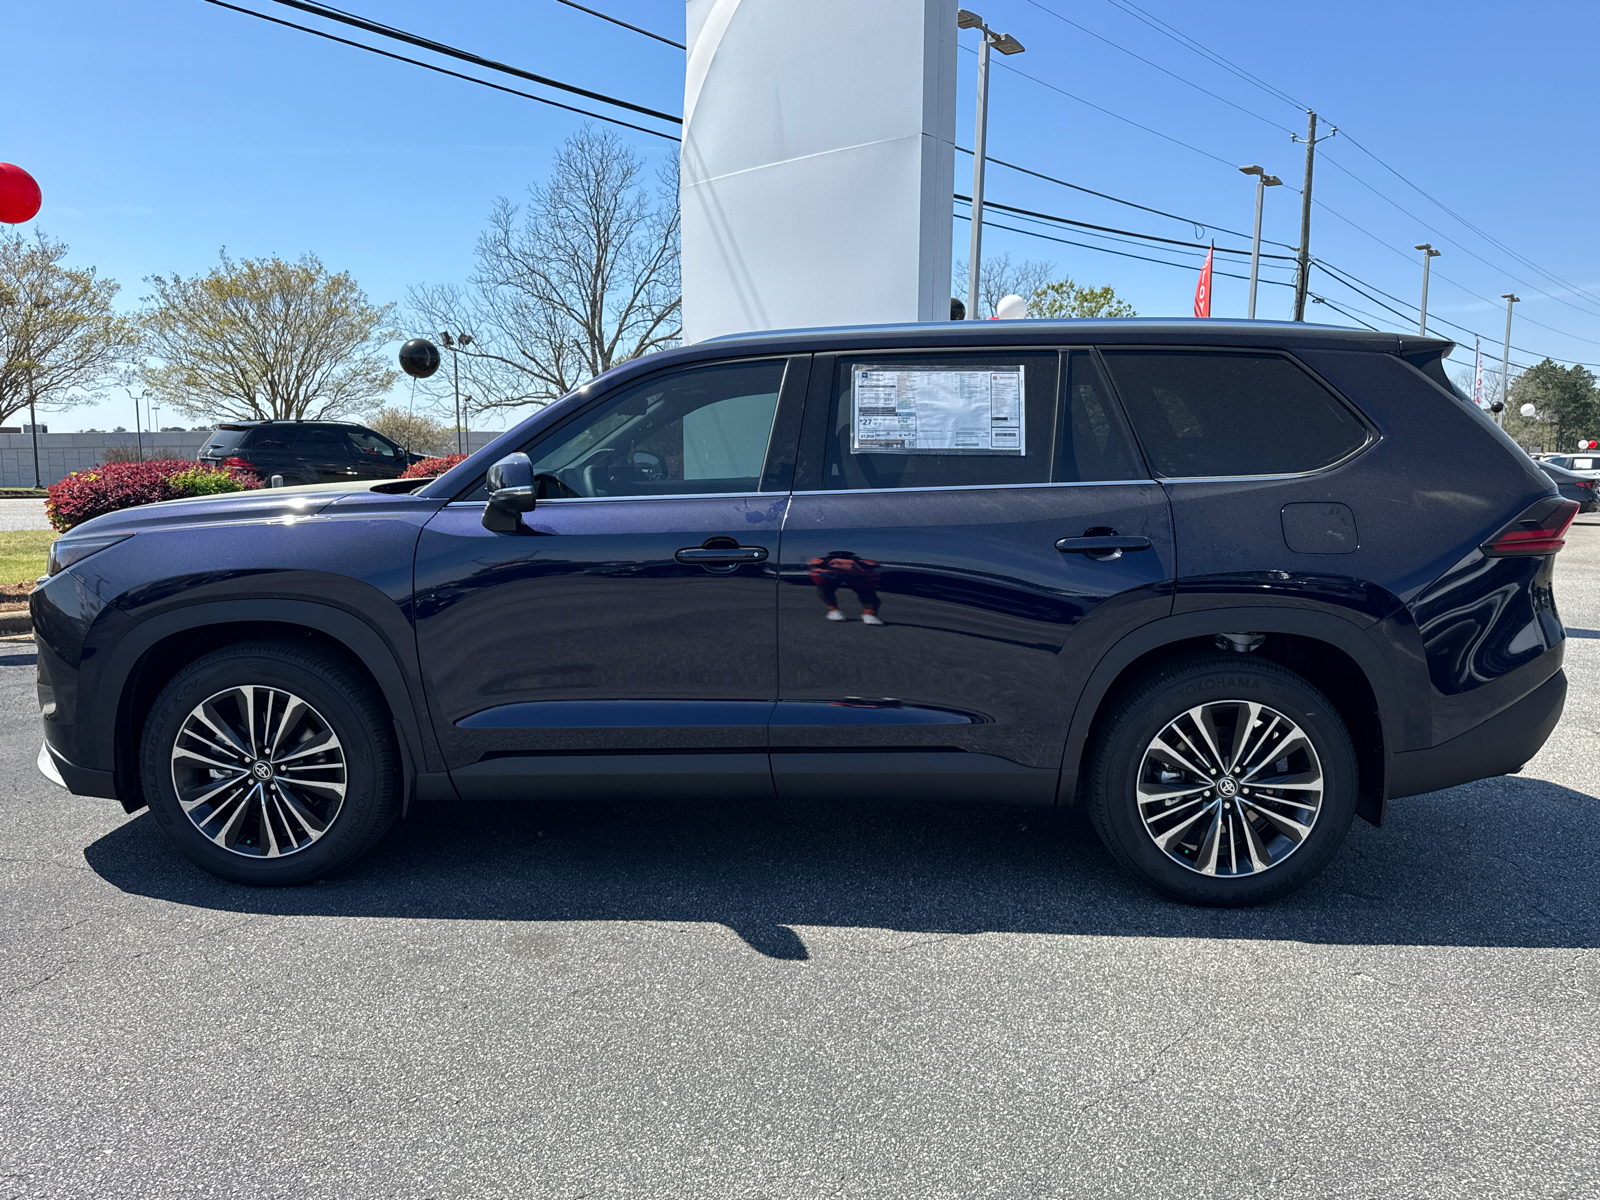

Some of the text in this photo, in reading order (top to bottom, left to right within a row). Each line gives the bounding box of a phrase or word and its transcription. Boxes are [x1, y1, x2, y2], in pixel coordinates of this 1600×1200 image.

[862, 418, 872, 426] 27
[1176, 676, 1261, 699] YOKOHAMA
[146, 678, 200, 826] GEOLANDAR X-CV
[325, 790, 369, 856] YOKOHAMA
